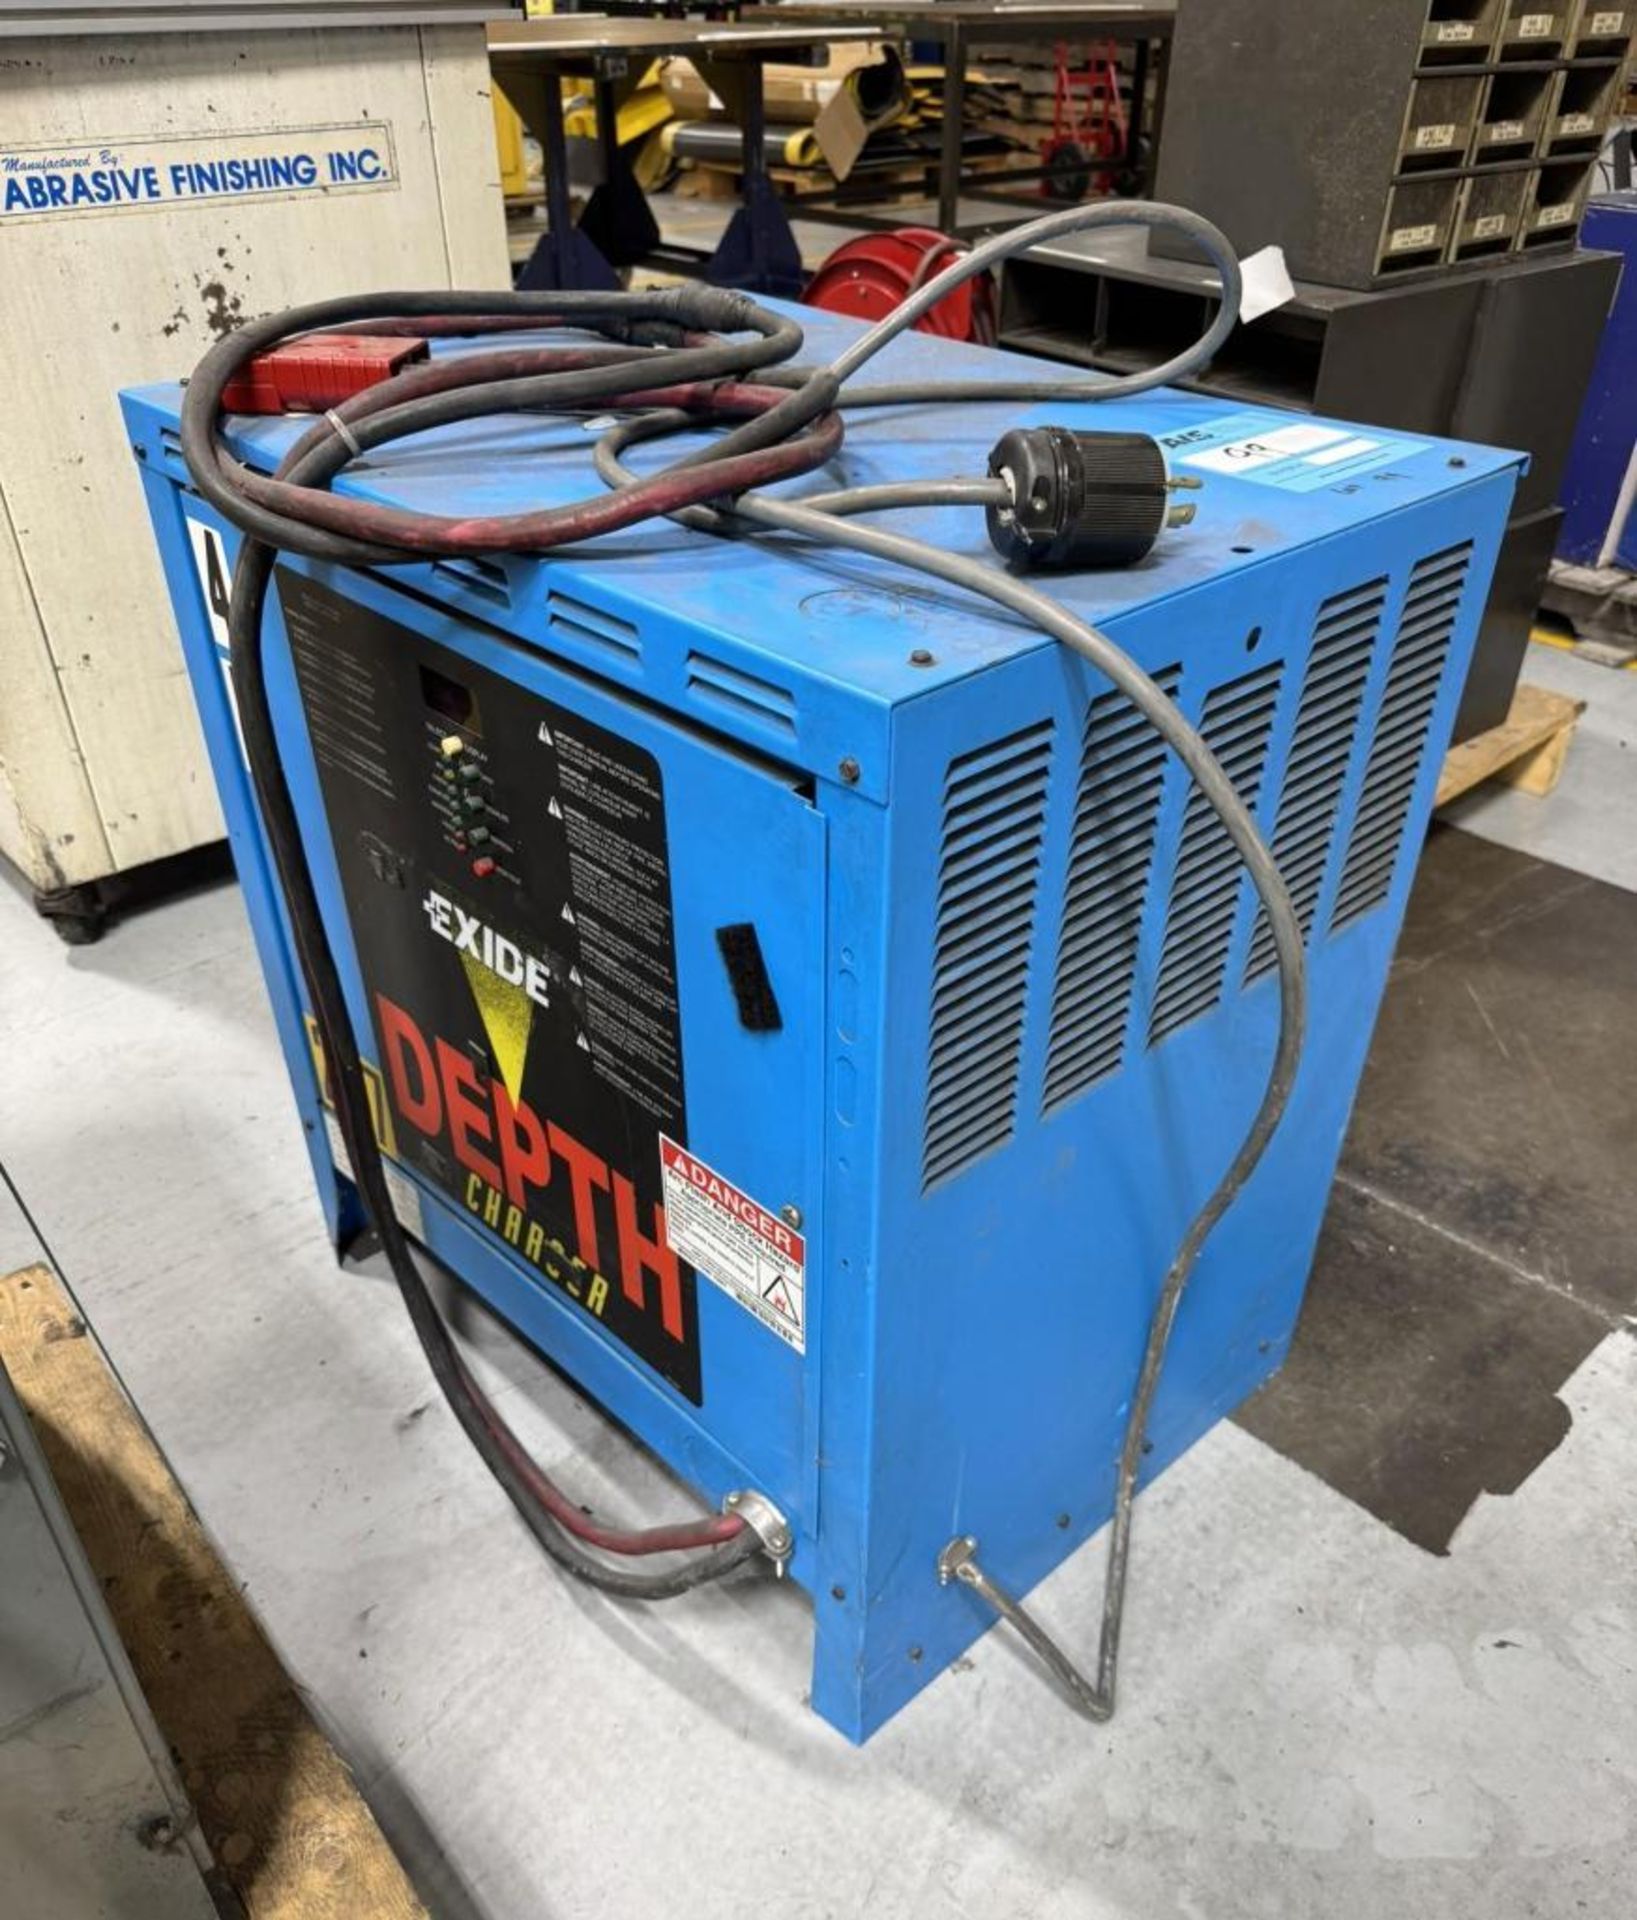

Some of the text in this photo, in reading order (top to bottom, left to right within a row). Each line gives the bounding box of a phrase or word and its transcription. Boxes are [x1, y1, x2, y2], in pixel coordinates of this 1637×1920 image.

[1, 156, 91, 174] Manufactured
[5, 148, 388, 211] ABRASIVE FINISHING INC.
[423, 889, 550, 1008] EXIDE
[375, 990, 684, 1343] DEPTH
[691, 1161, 791, 1254] DANGER
